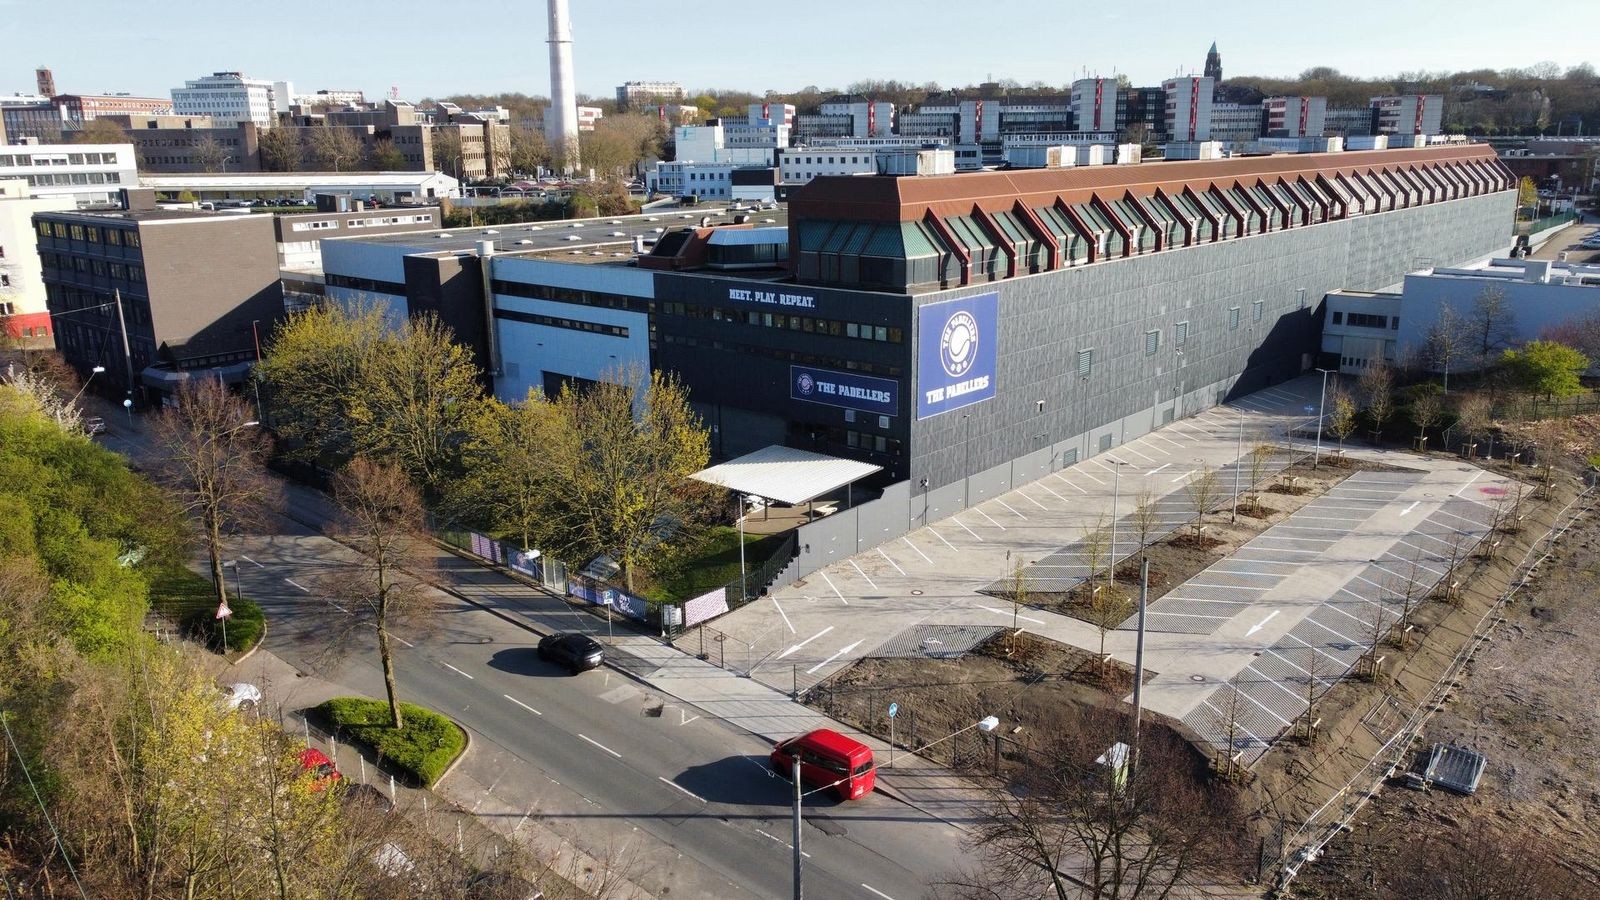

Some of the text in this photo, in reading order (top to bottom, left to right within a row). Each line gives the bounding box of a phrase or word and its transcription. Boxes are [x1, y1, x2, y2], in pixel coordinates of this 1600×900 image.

[729, 288, 815, 308] MEET. PLAY. REPEAT.
[816, 381, 891, 403] THE PADELLERS
[926, 375, 990, 405] THE PADELLERS
